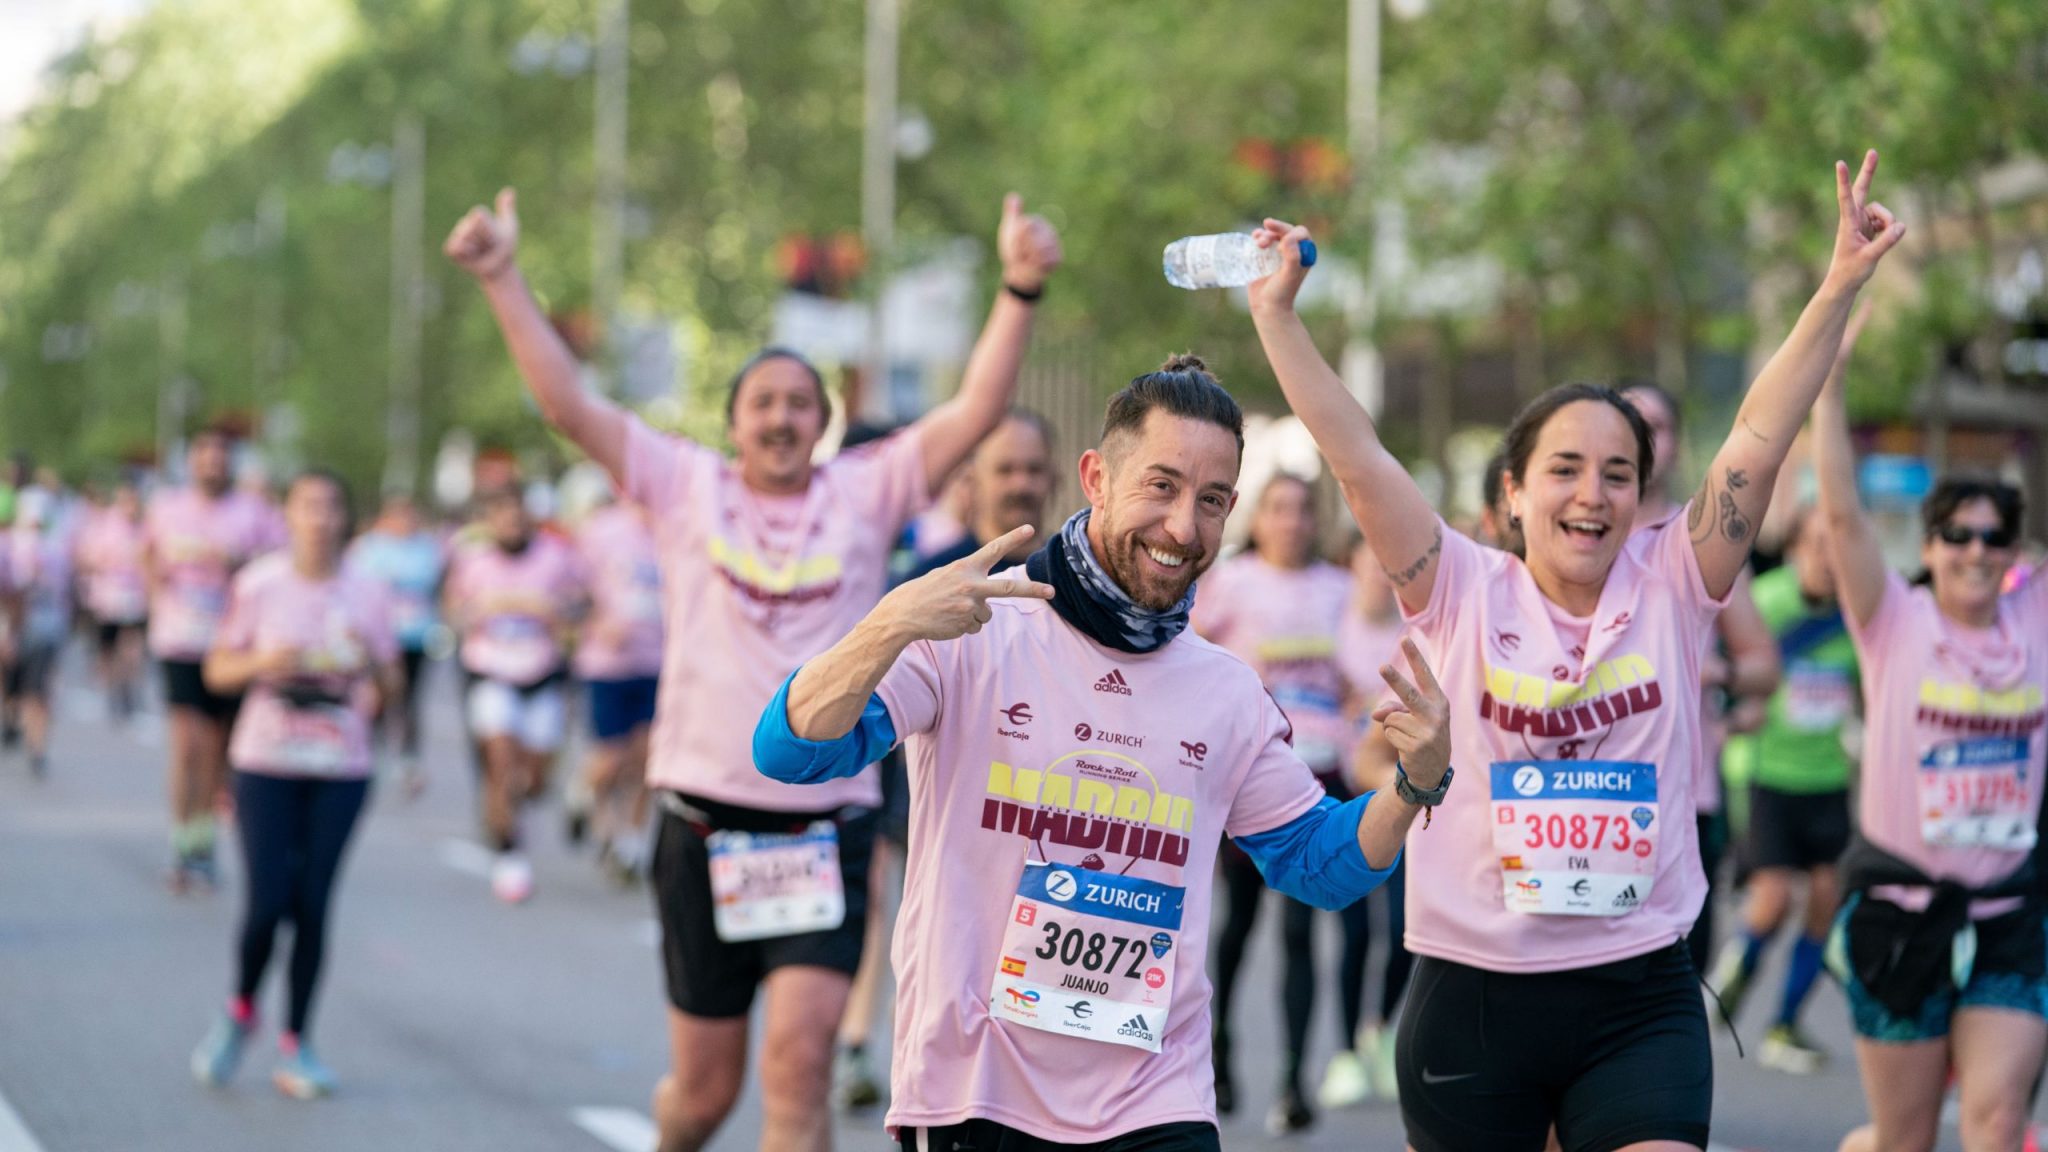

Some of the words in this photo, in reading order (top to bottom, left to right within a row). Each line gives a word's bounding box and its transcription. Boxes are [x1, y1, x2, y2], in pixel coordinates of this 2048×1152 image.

[1094, 681, 1132, 696] adidas
[1096, 730, 1143, 749] ZURICH
[1076, 760, 1104, 772] Rock
[1114, 767, 1139, 778] Roll
[1552, 771, 1632, 792] ZURICH
[1524, 814, 1631, 851] 30873
[1568, 857, 1590, 870] EVA
[1084, 883, 1160, 913] ZURICH
[1020, 908, 1032, 922] 5
[1035, 921, 1148, 979] 30872
[1060, 973, 1109, 995] JUANJO
[1117, 1026, 1153, 1041] adidas
